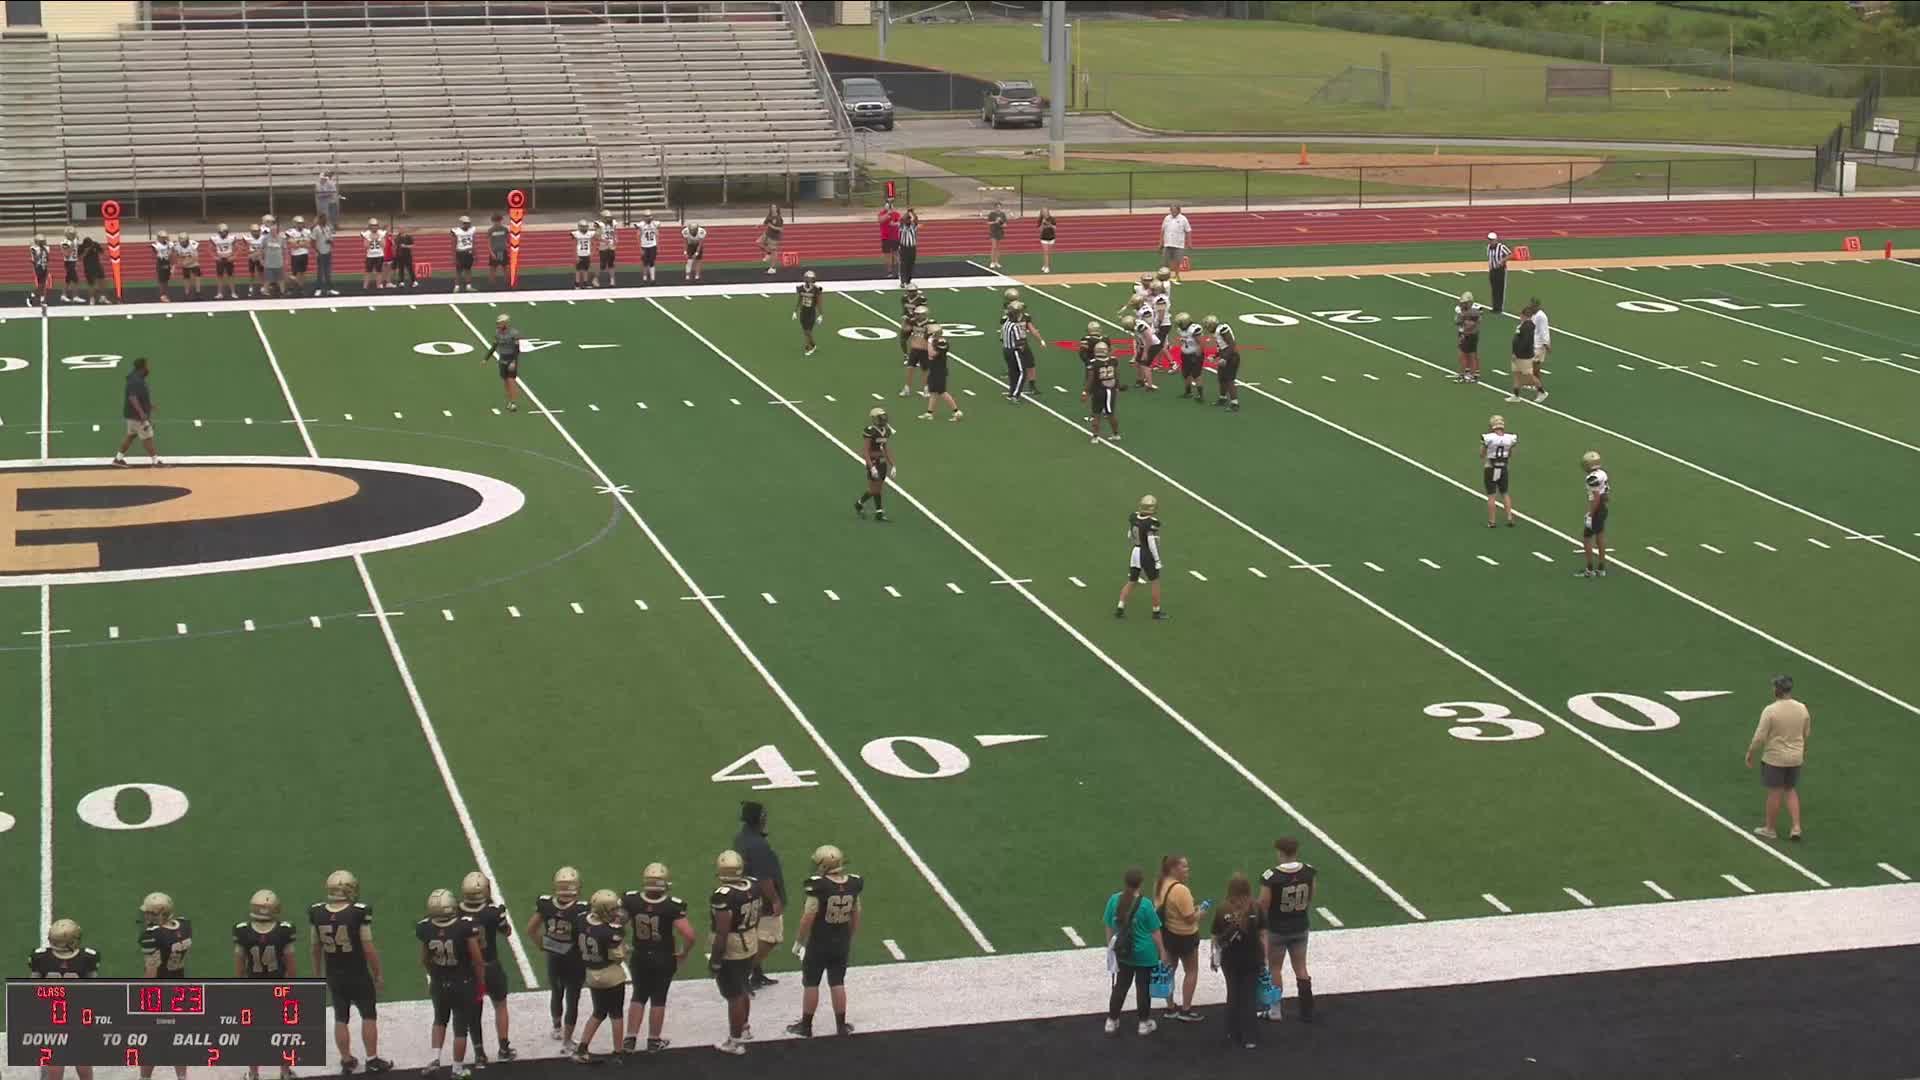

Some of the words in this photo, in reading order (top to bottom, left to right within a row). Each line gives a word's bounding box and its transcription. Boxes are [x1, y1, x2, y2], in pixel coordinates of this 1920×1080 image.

[1280, 883, 1310, 912] 50
[318, 925, 353, 952] 54
[250, 945, 279, 972] 14
